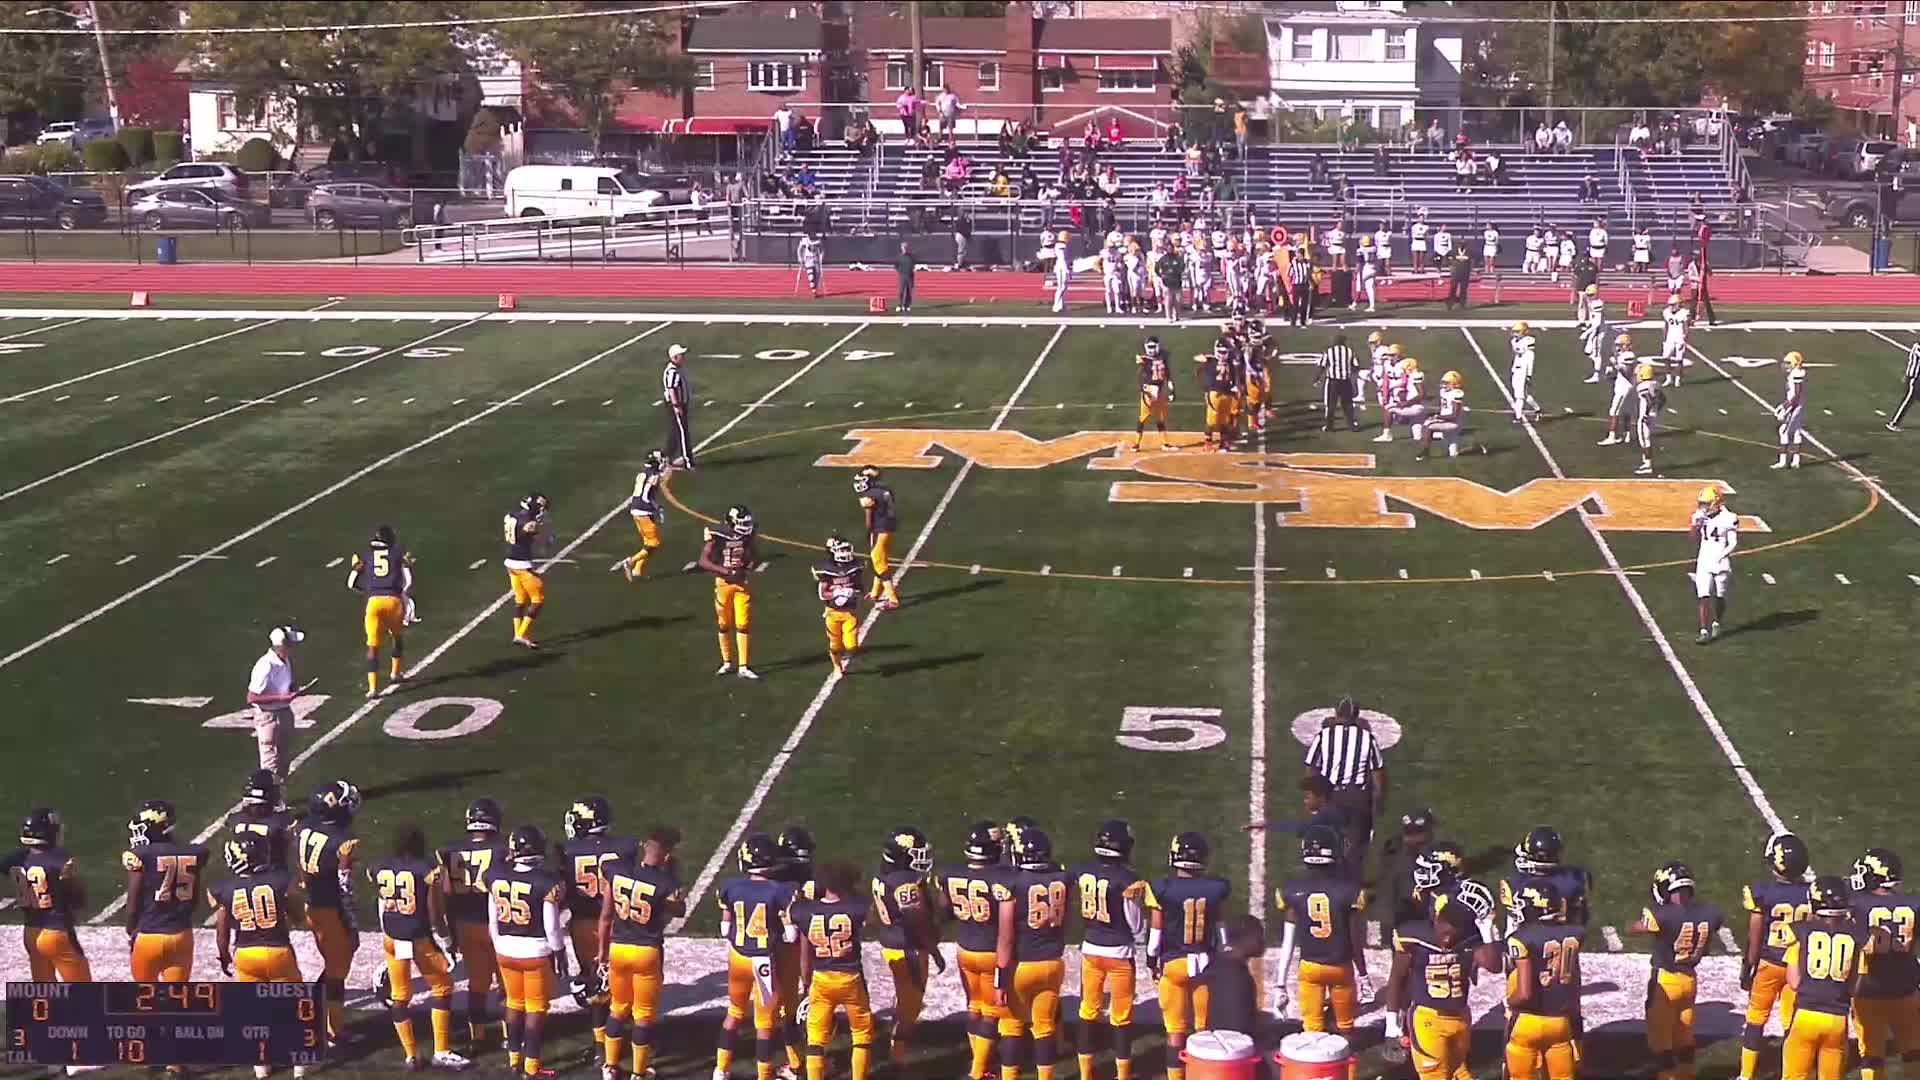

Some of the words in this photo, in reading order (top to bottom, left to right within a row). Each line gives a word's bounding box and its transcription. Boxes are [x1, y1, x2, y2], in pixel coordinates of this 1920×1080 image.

[1703, 524, 1720, 542] 14
[373, 549, 389, 577] 5
[299, 828, 329, 873] 17
[155, 855, 197, 902] 75
[612, 874, 656, 924] 55
[947, 876, 991, 922] 56
[1078, 872, 1111, 924] 81
[231, 884, 278, 931] 40
[491, 879, 532, 925] 65
[733, 901, 767, 949] 14
[1183, 898, 1207, 945] 11
[1306, 892, 1331, 938] 9
[808, 912, 853, 958] 42
[1673, 921, 1709, 963] 41
[1806, 930, 1856, 983] 80
[1540, 936, 1579, 988] 30
